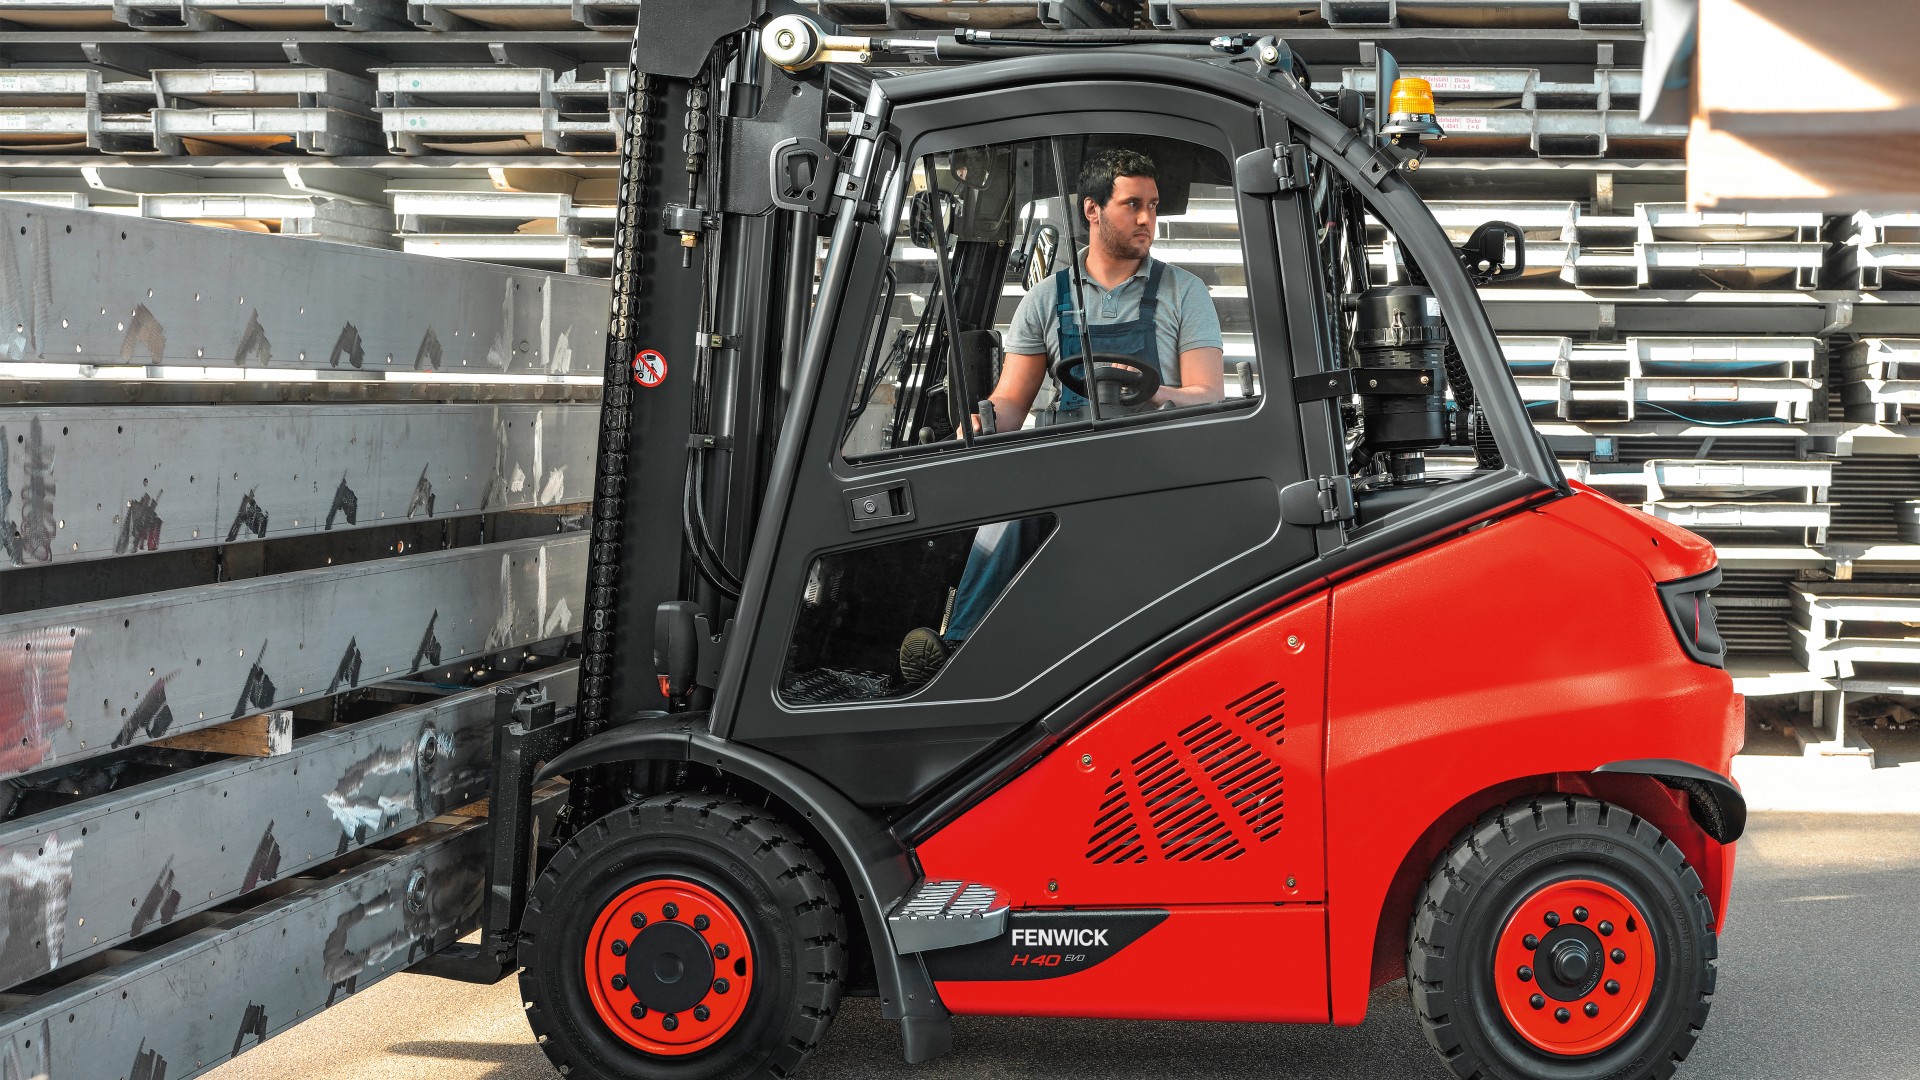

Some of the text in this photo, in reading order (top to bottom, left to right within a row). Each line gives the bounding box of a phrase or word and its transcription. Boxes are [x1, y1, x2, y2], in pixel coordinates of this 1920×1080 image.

[1011, 928, 1109, 947] FENWICK
[1010, 954, 1086, 967] H 40 EVO
